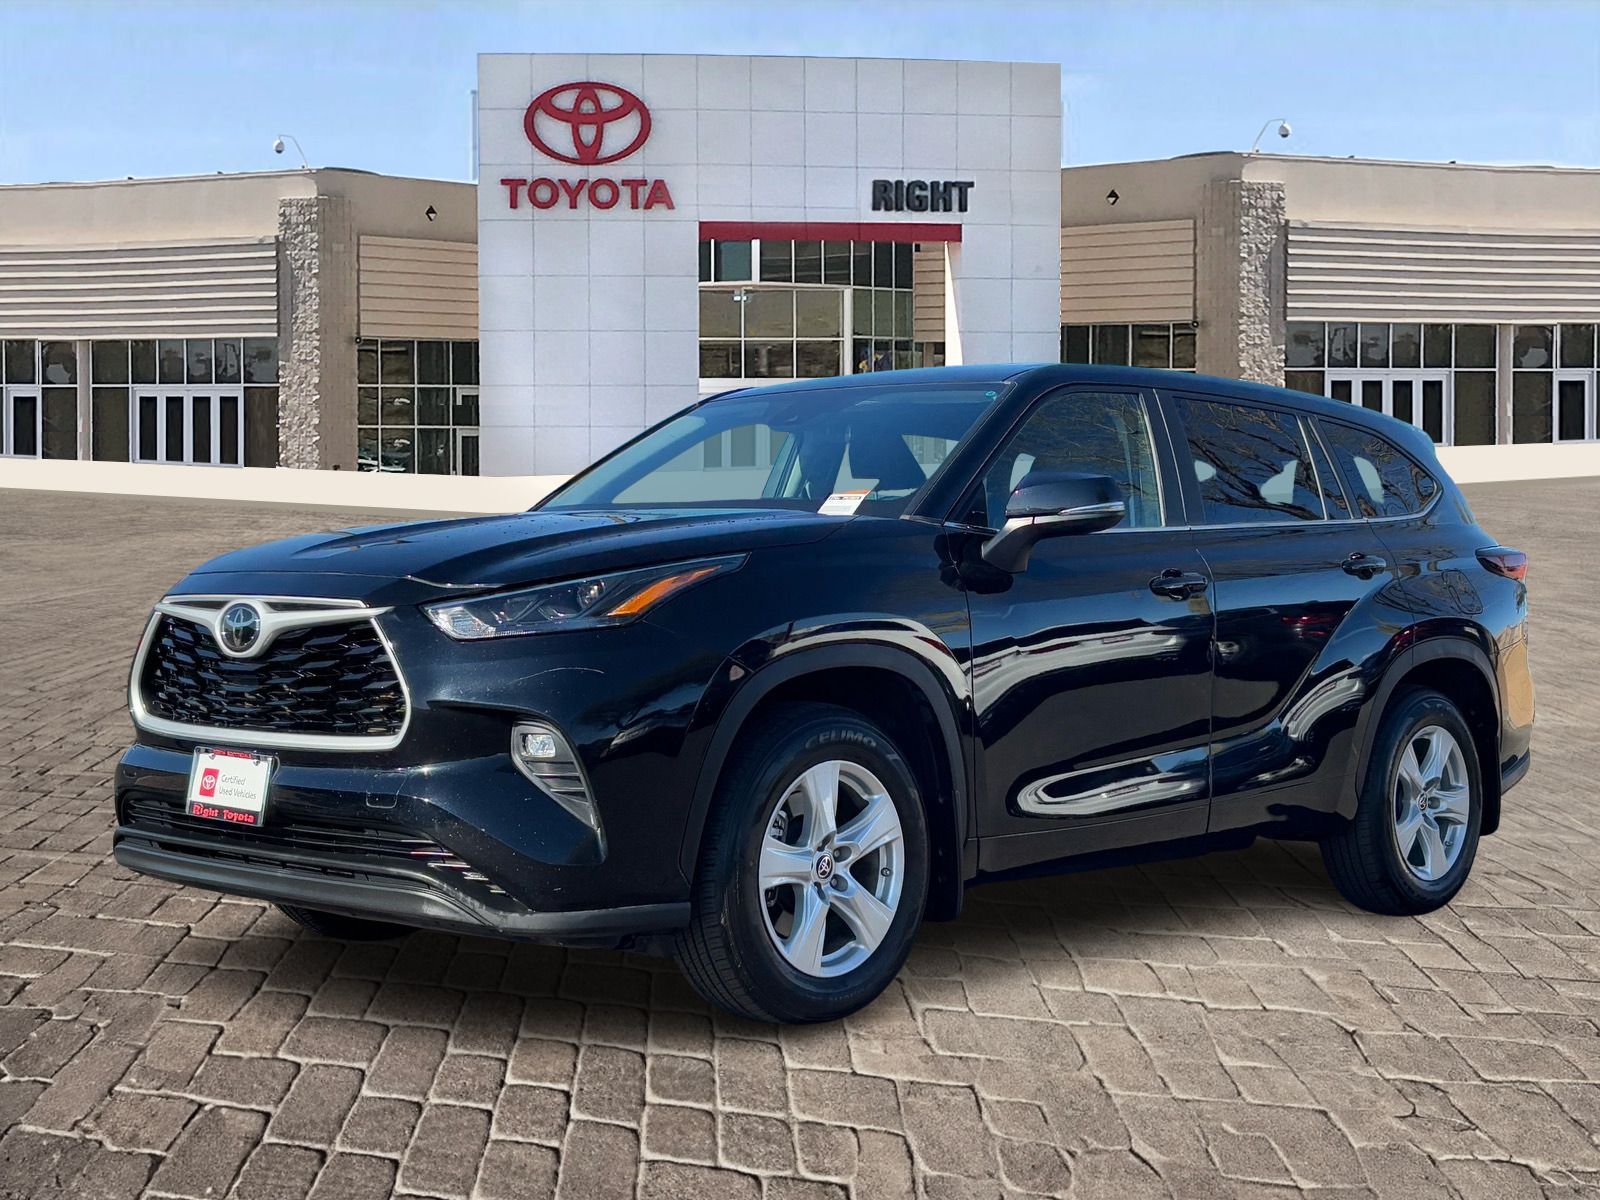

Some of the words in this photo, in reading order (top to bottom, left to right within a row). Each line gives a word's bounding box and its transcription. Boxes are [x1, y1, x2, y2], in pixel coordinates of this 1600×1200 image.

[500, 178, 675, 210] TOYOTA
[872, 179, 974, 213] RIGHT
[221, 775, 246, 785] Certified
[219, 787, 233, 796] Used
[234, 789, 256, 799] Vehicles
[193, 804, 219, 817] Right
[223, 810, 255, 822] Toyota
